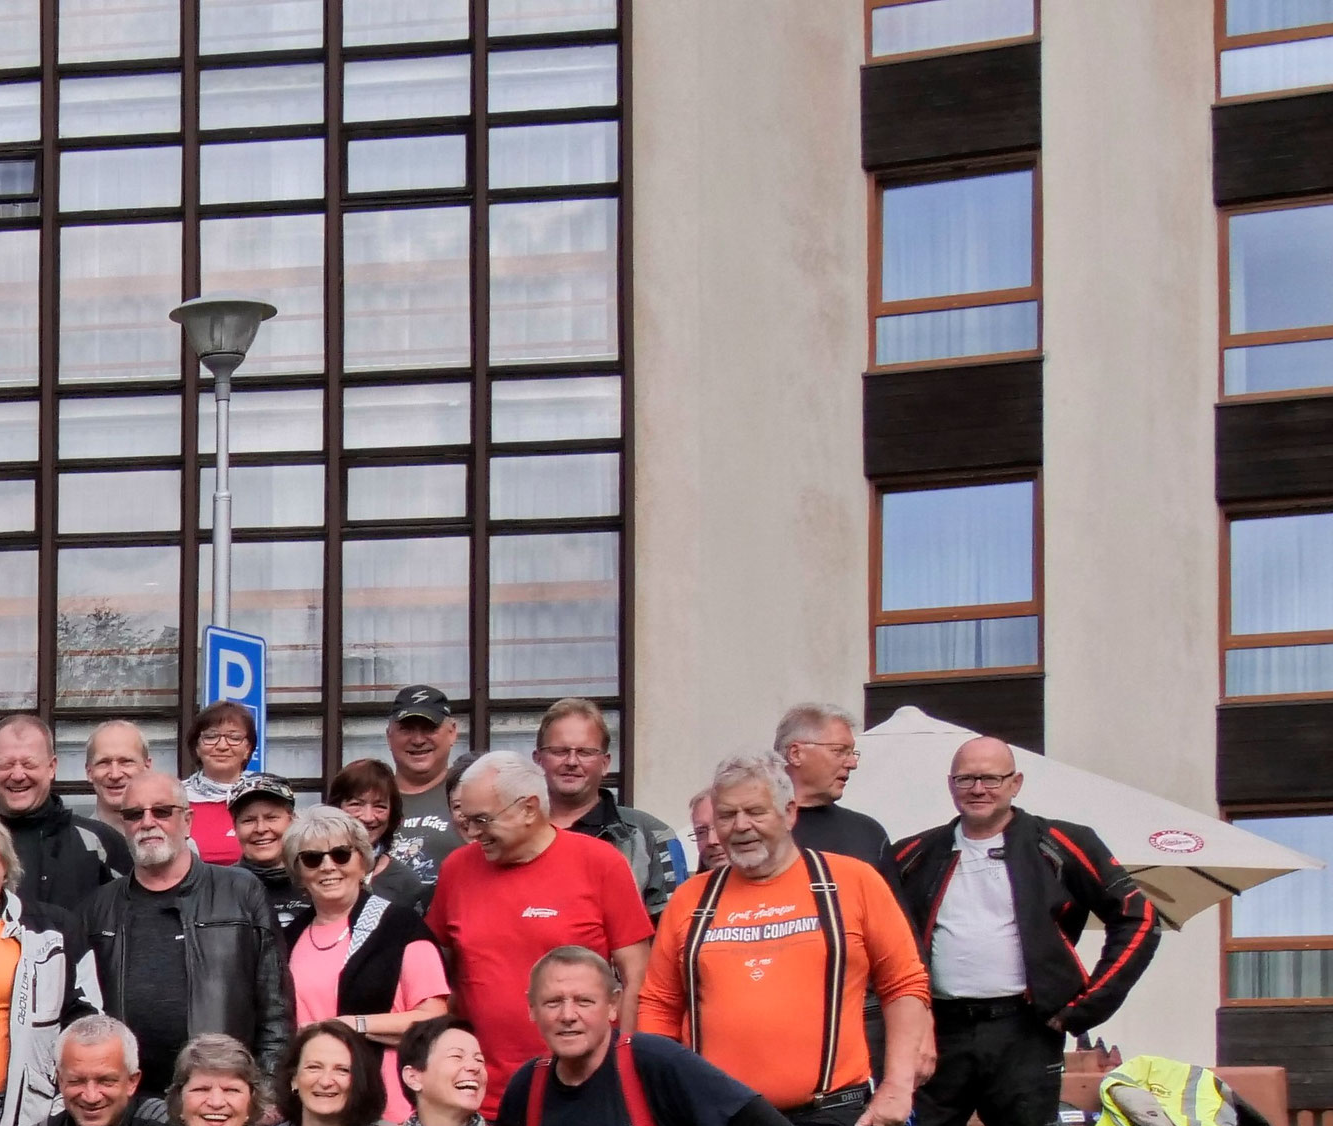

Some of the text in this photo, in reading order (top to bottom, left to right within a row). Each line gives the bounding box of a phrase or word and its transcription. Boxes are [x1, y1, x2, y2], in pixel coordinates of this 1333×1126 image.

[219, 649, 253, 702] P
[404, 817, 421, 828] MY
[763, 917, 820, 939] COMPANY
[841, 1091, 863, 1102] DRIV
